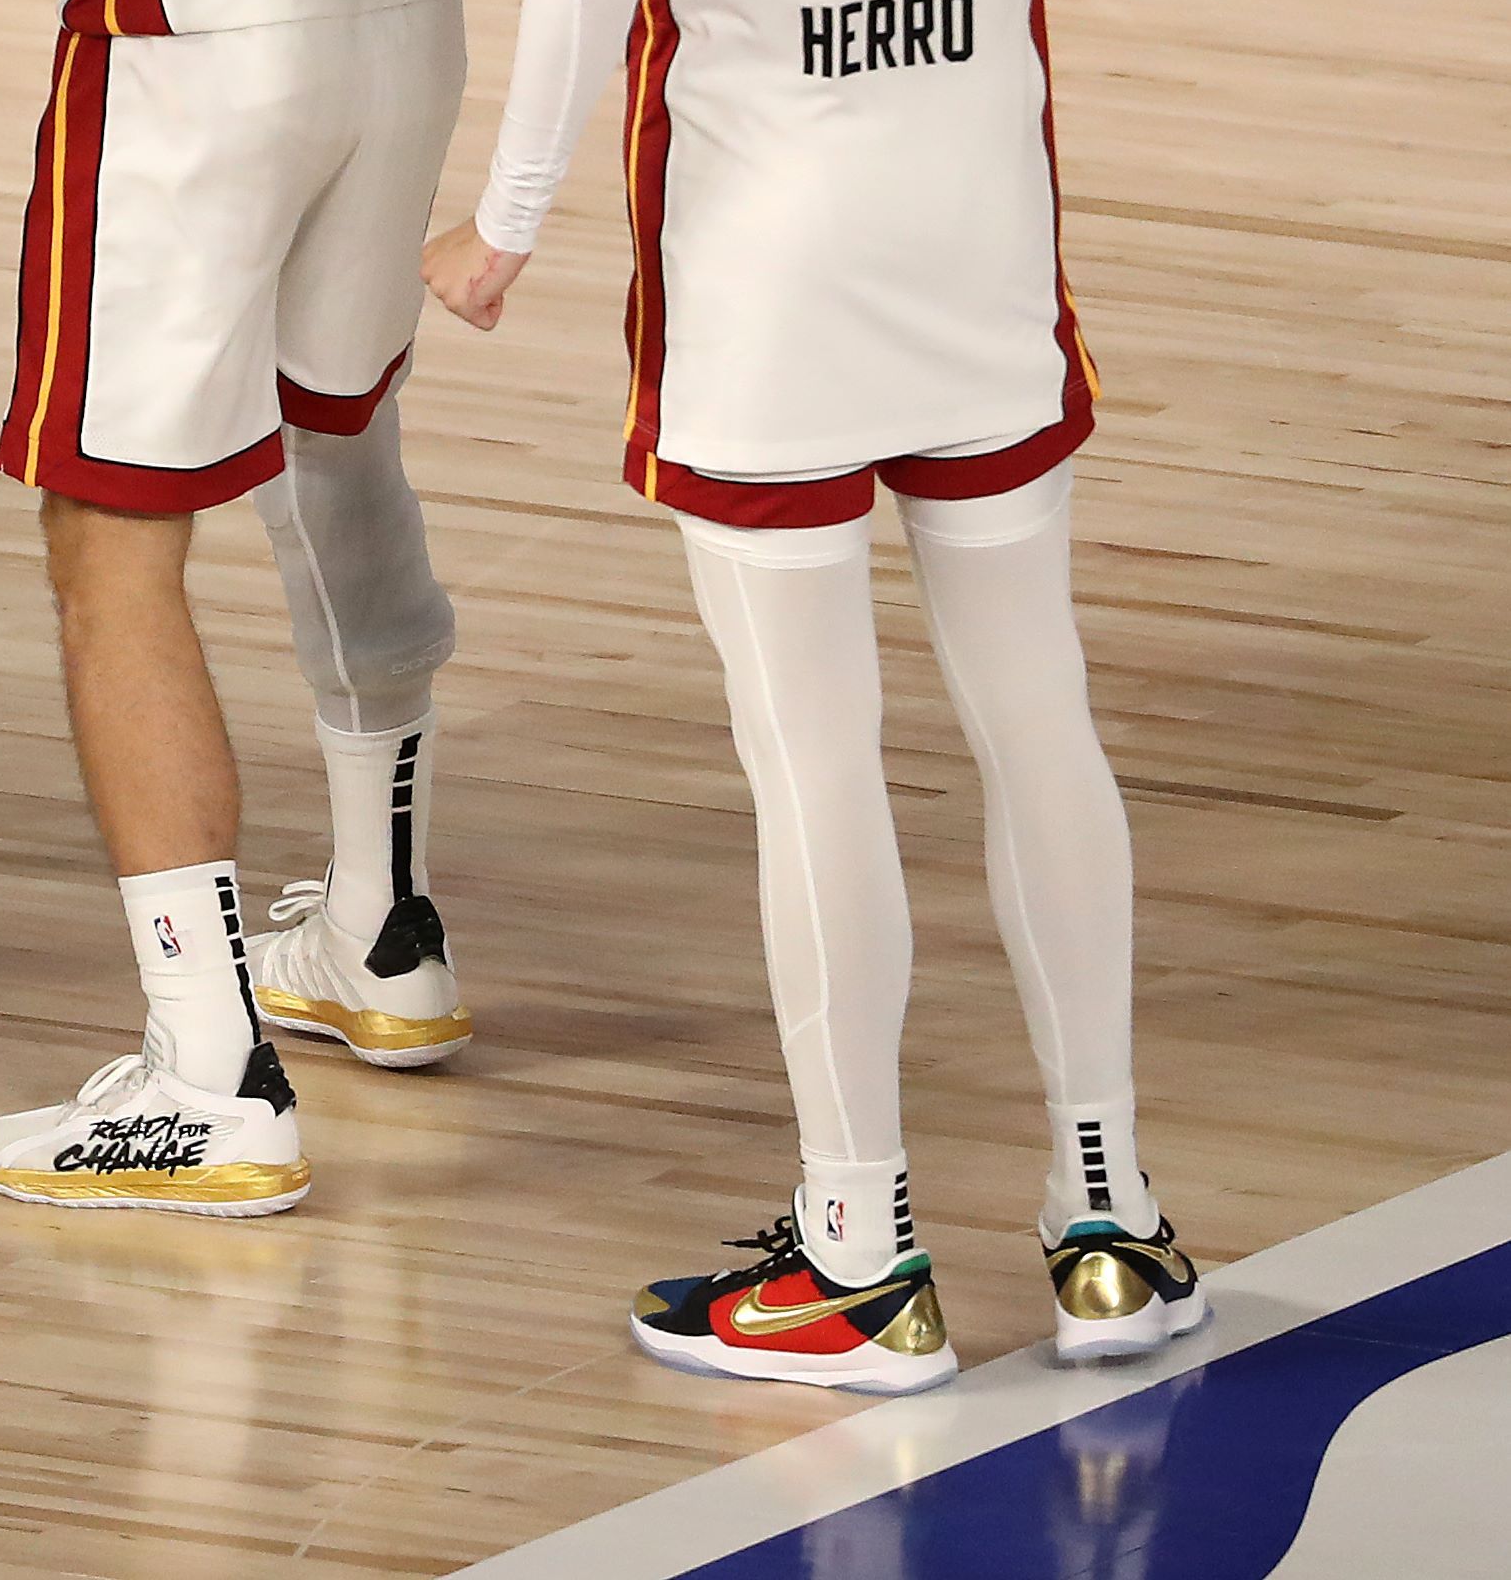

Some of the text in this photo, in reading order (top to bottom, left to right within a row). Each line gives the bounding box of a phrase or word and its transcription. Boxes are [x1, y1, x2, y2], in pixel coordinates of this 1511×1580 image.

[88, 1112, 211, 1142] READY FOR
[54, 1138, 209, 1177] CHANGE
